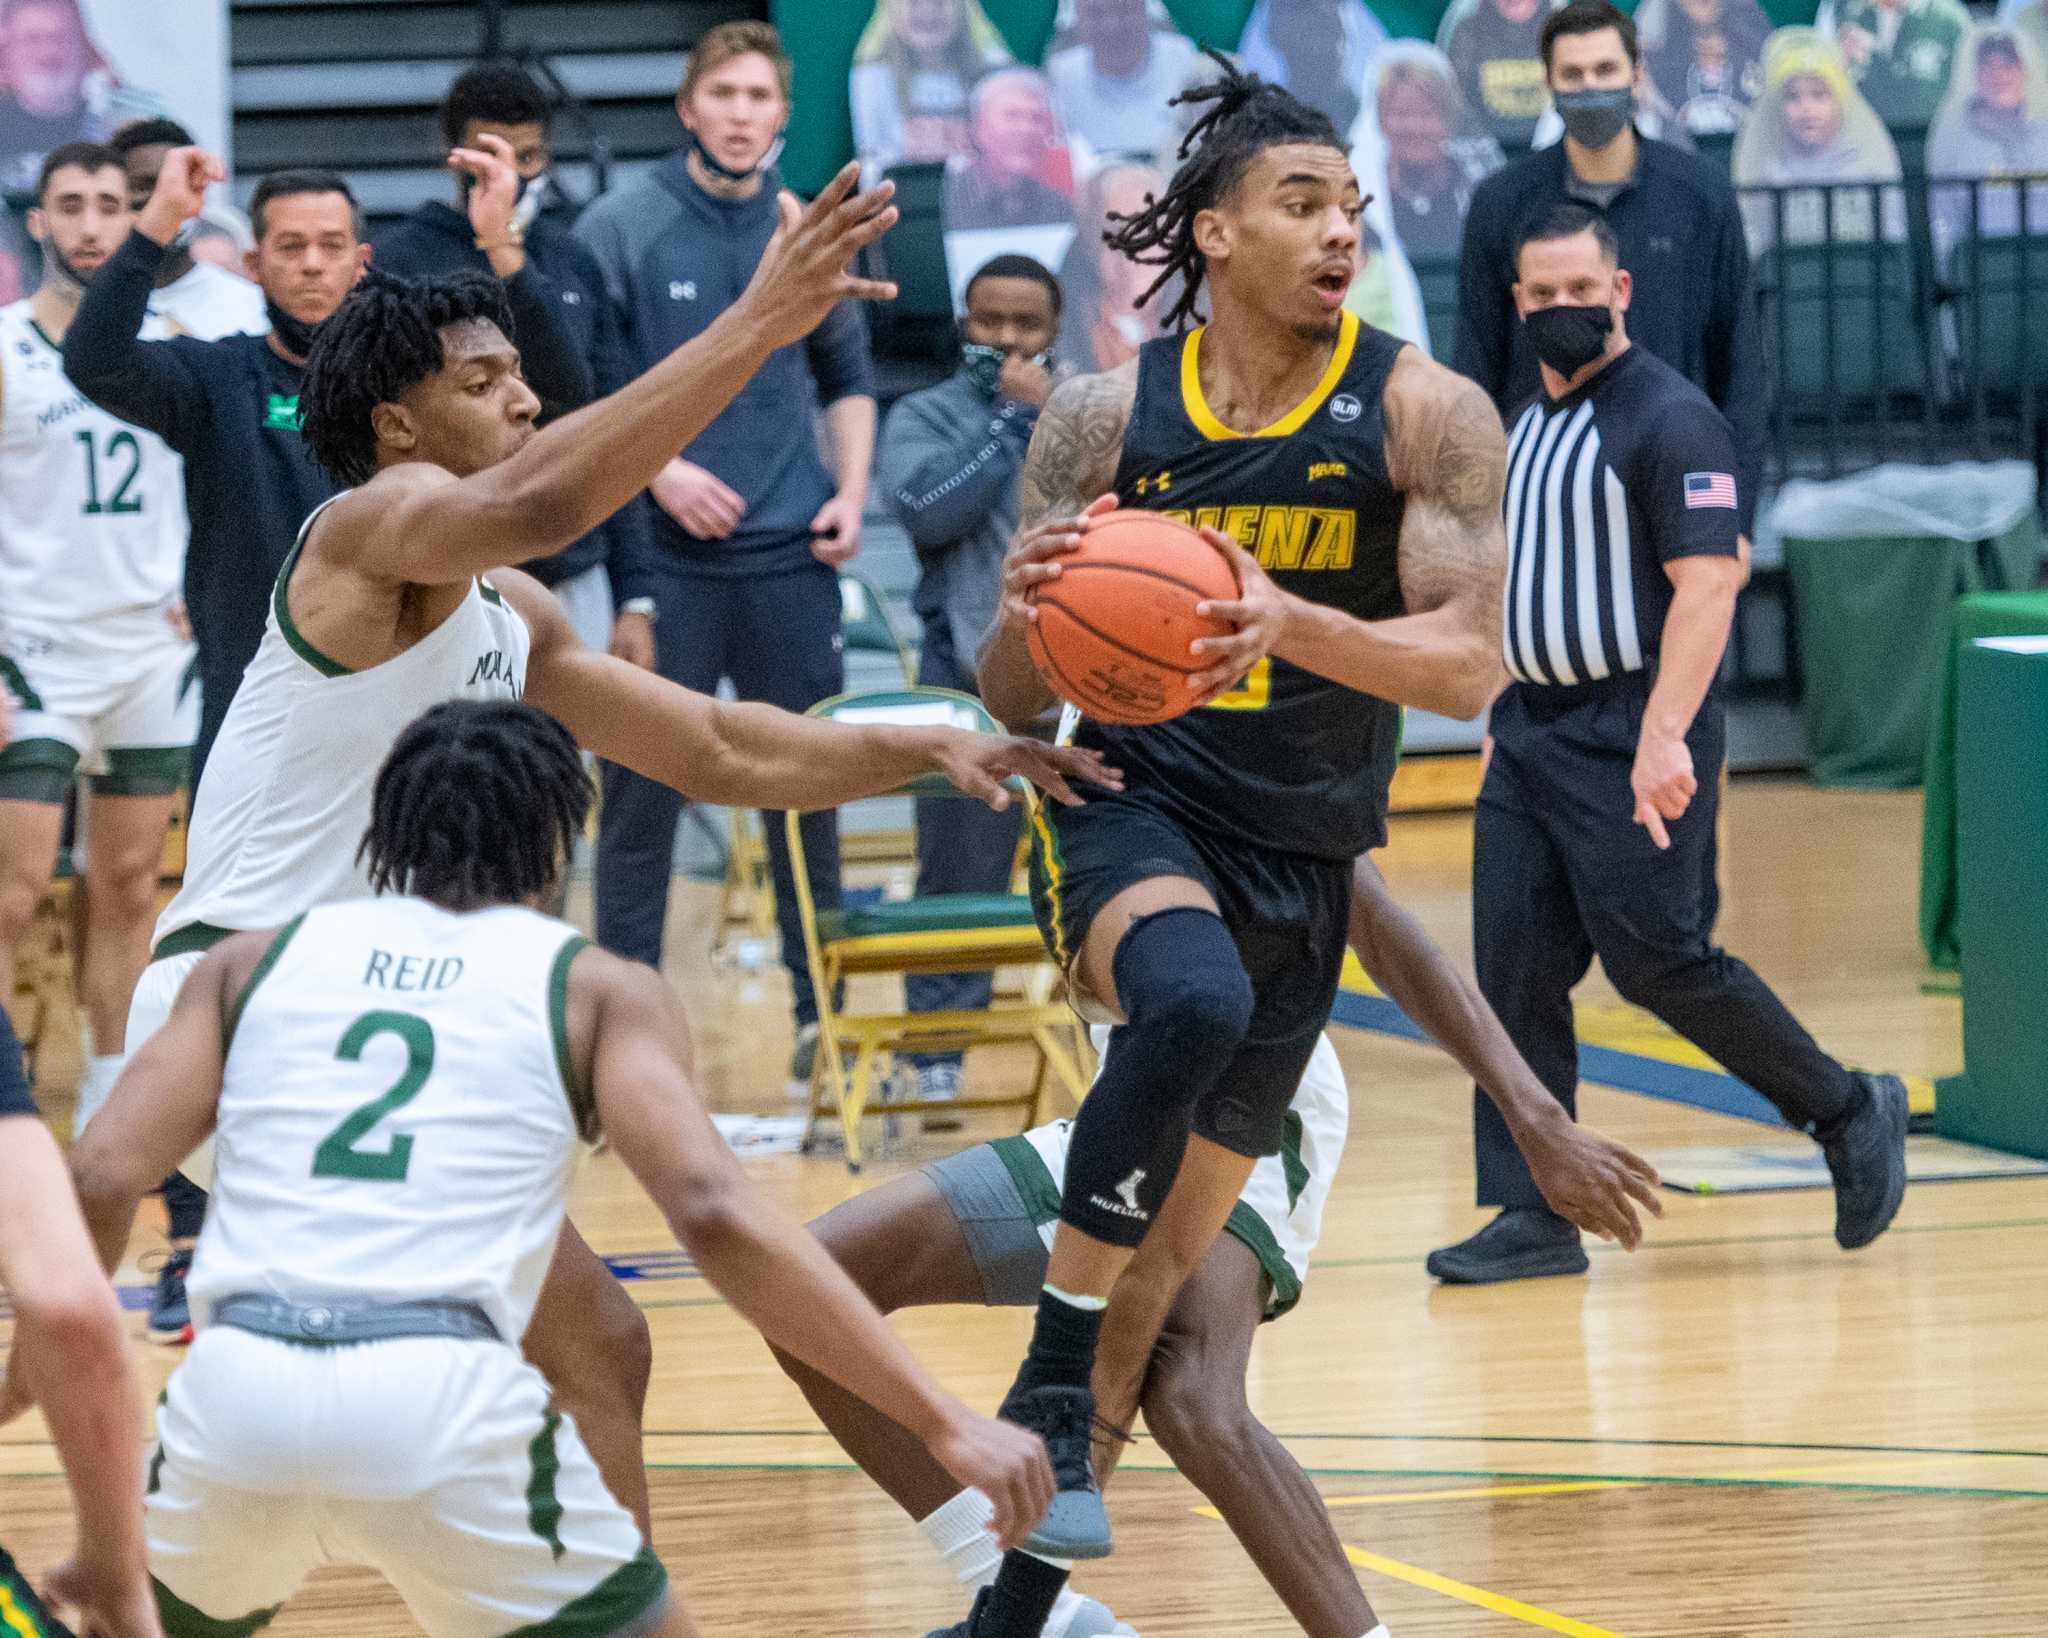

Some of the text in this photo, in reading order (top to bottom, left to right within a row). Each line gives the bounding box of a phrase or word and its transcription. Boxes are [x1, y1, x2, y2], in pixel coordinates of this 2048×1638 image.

[1333, 399, 1359, 416] BLM
[75, 431, 144, 513] 12
[362, 948, 465, 992] REID
[310, 1008, 436, 1183] 2
[1090, 1194, 1149, 1220] MUELLER
